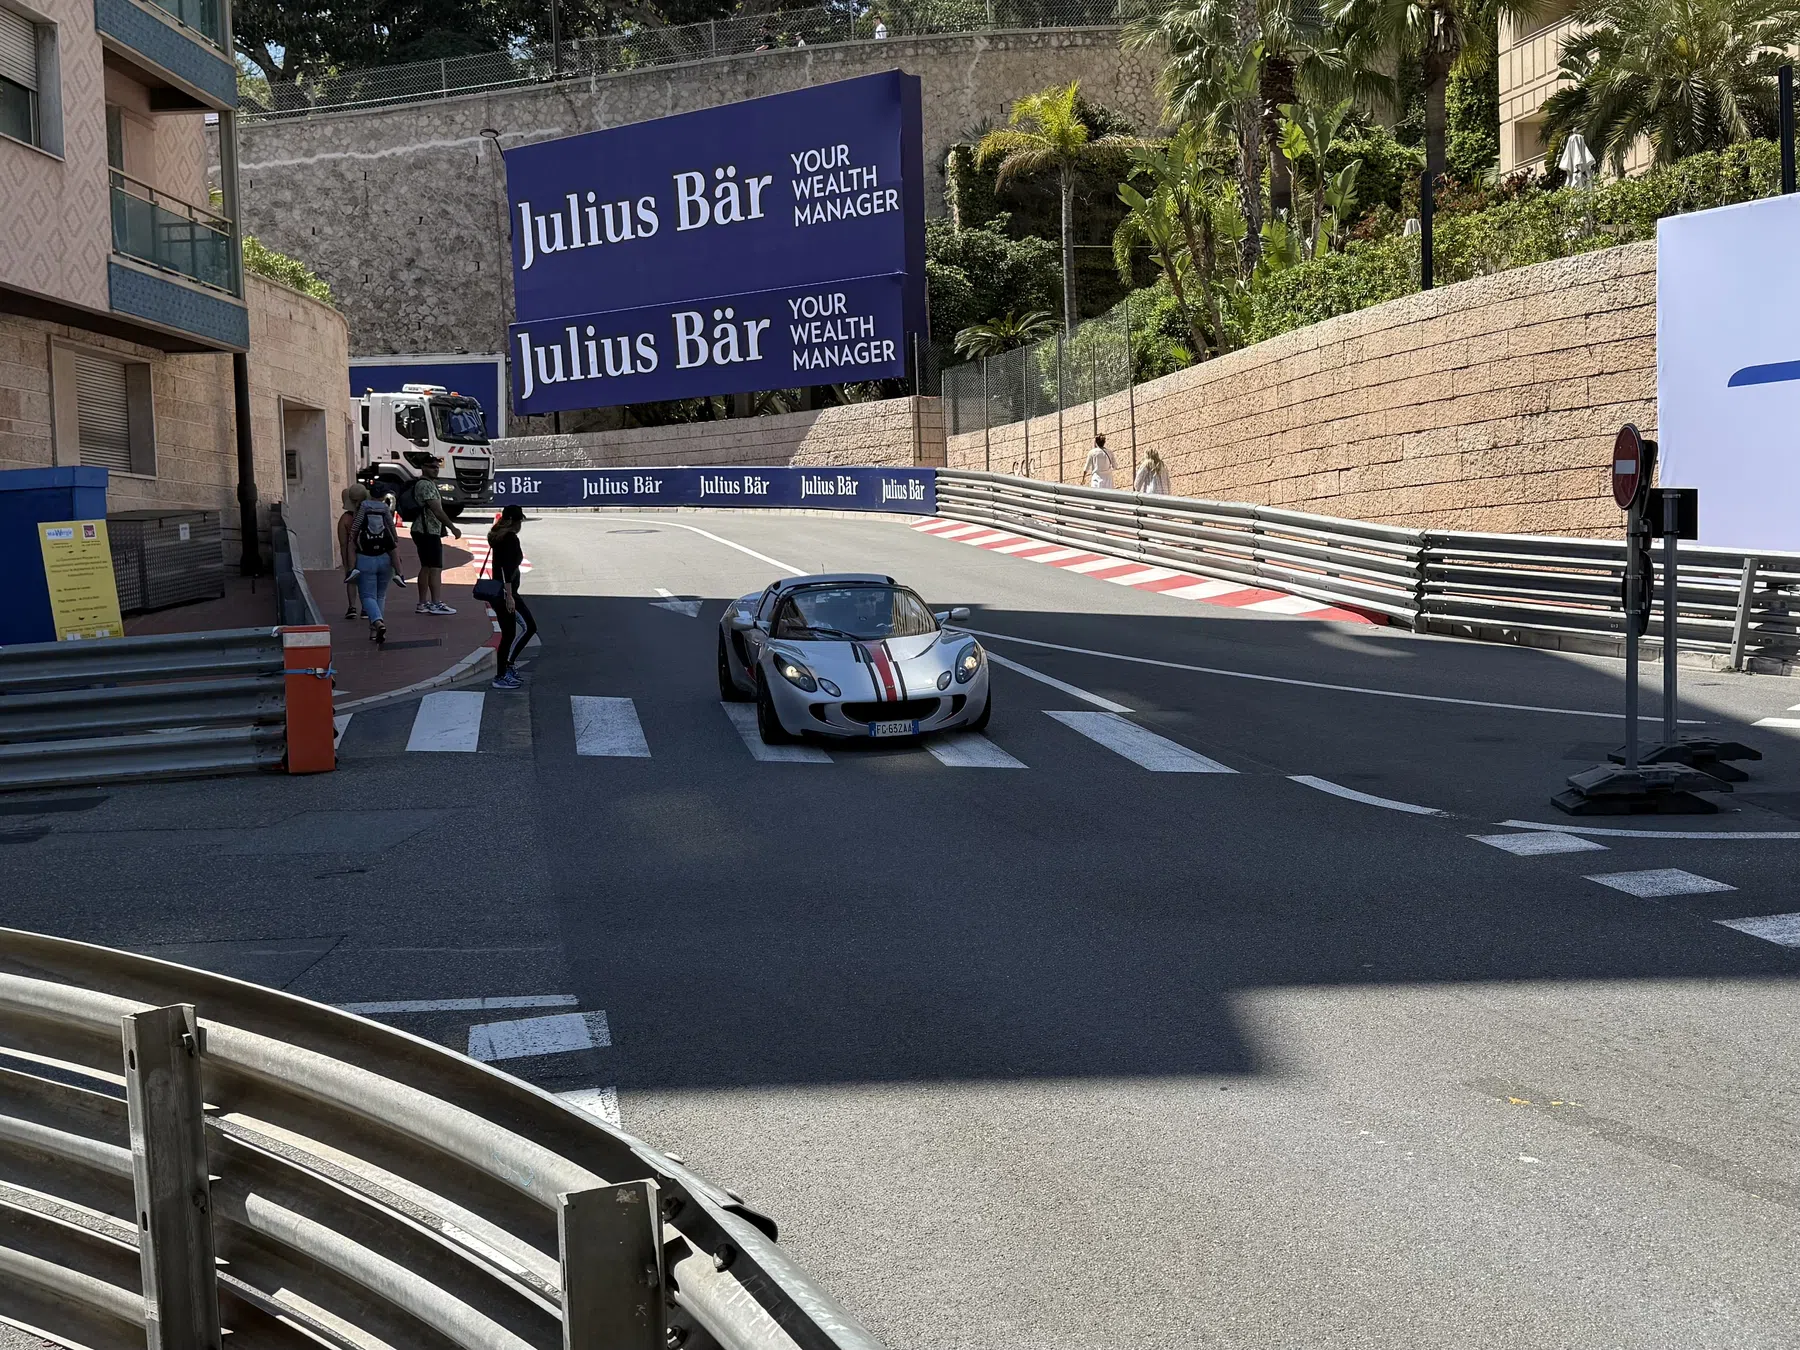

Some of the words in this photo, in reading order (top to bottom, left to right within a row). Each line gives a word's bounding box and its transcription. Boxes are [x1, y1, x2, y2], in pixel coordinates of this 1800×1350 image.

[790, 144, 851, 175] YOUR
[791, 164, 878, 201] WEALTH
[517, 191, 659, 271] Julius
[672, 165, 773, 232] Bär
[794, 188, 900, 227] MANAGER
[787, 292, 848, 320] YOUR
[789, 315, 875, 346] WEALTH
[517, 324, 659, 400] Julius
[671, 307, 771, 370] Bär
[792, 339, 896, 371] MANAGER
[510, 476, 542, 494] Bär
[582, 477, 629, 500] Julius
[632, 476, 663, 494] Bär
[699, 475, 741, 498] Julius
[743, 475, 770, 495] Bär
[800, 475, 835, 499] Julius
[836, 475, 859, 496] Bär
[881, 478, 908, 503] Julius
[908, 479, 926, 501] Bär
